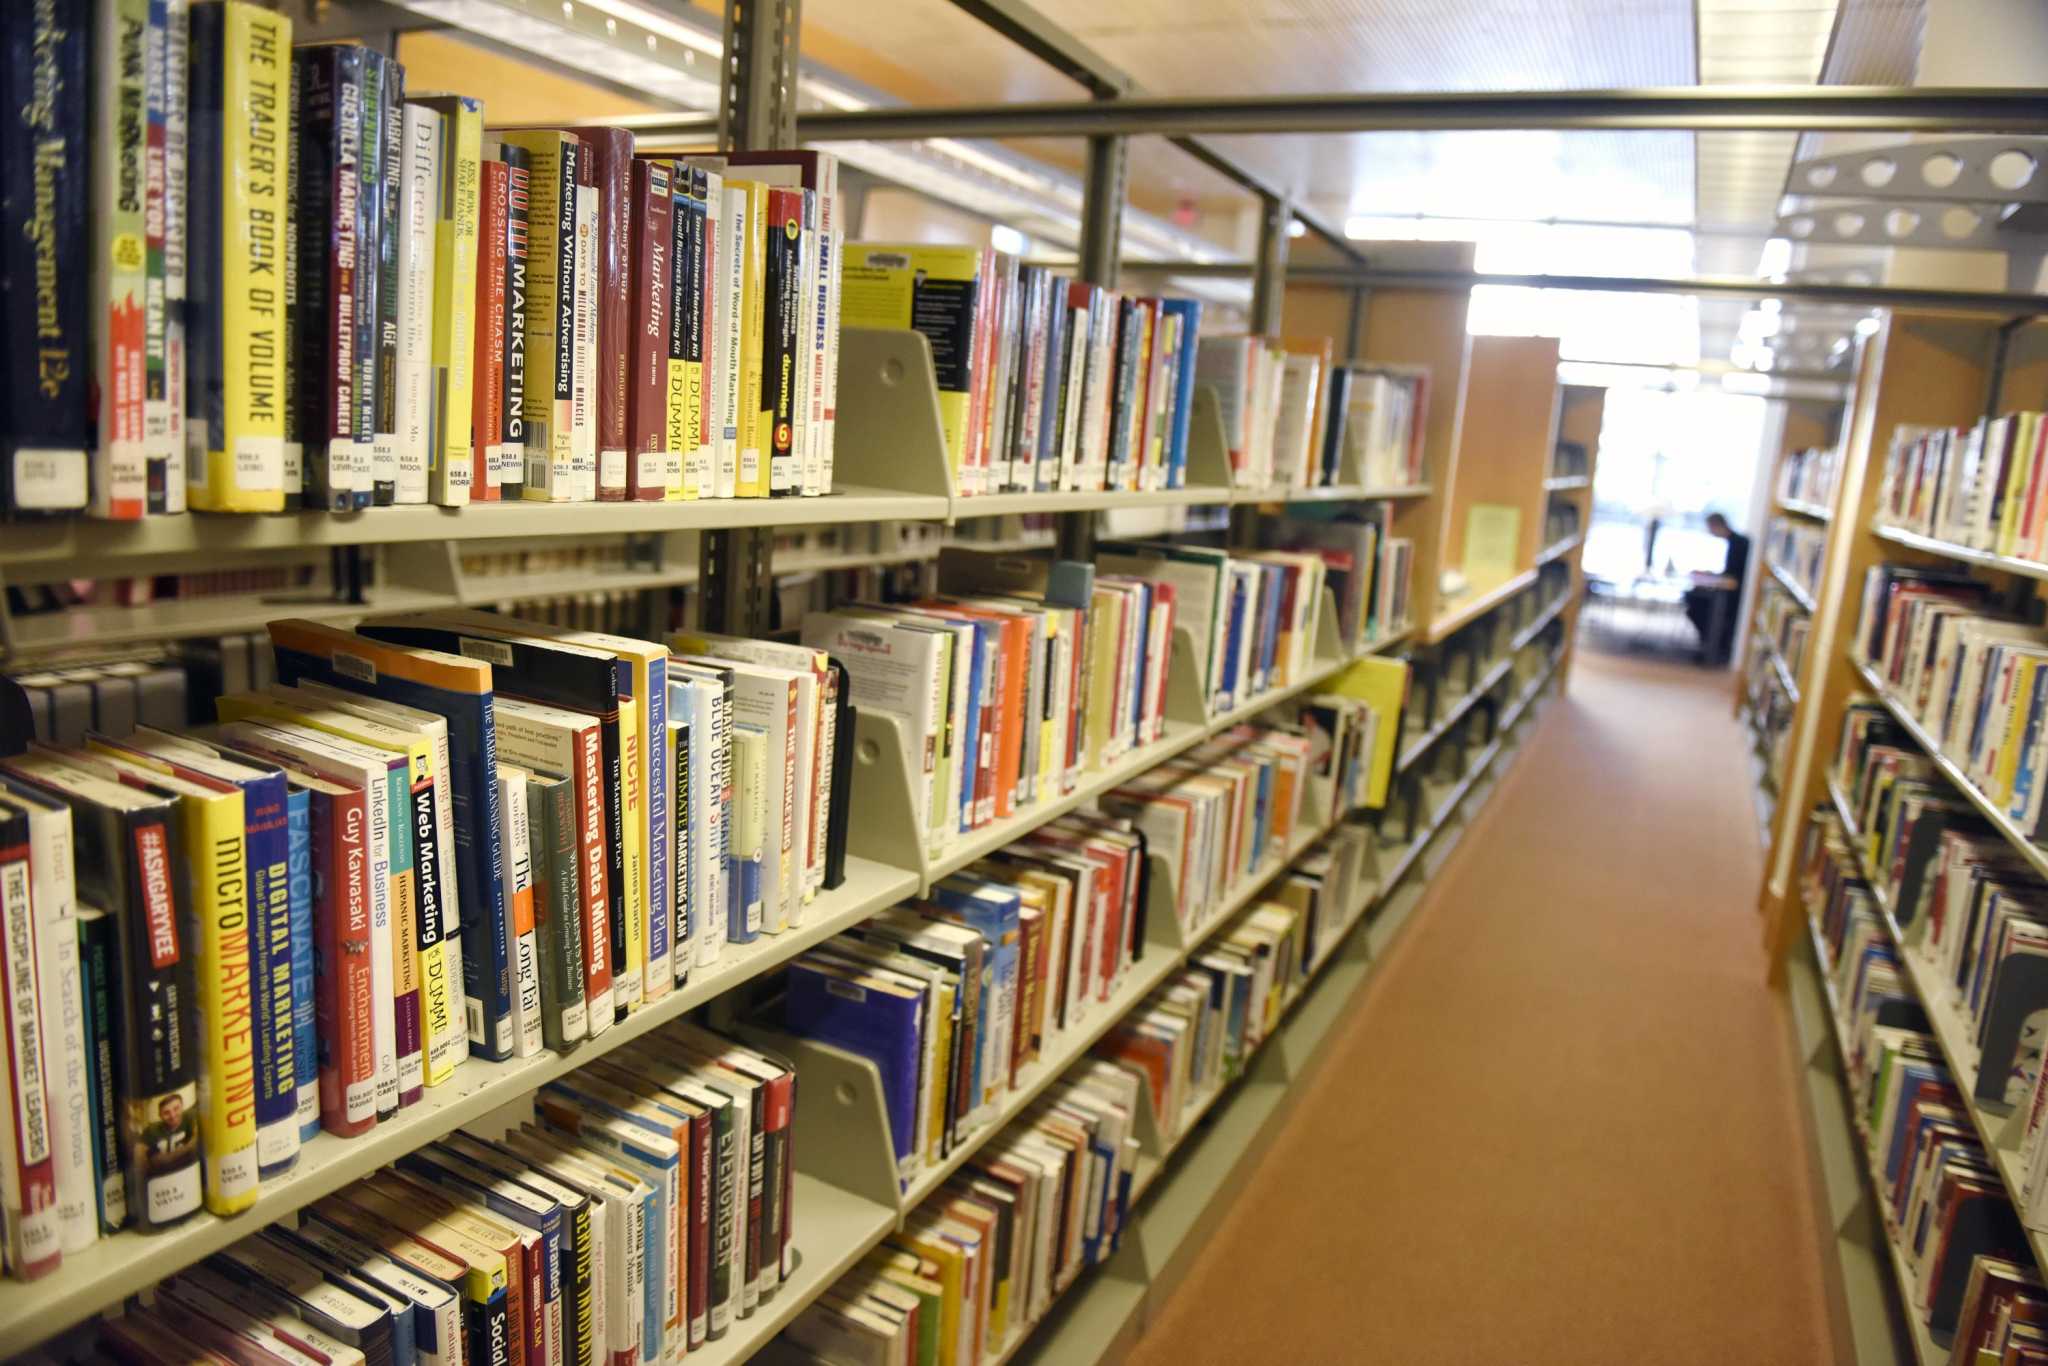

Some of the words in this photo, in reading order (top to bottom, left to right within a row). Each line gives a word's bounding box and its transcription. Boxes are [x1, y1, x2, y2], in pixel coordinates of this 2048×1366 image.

[250, 22, 276, 70] THE
[250, 80, 276, 198] TRADER'S
[339, 82, 359, 166] GUERILLA
[386, 106, 402, 187] MARKETING
[147, 147, 165, 195] LIKE
[414, 124, 433, 236] Different
[508, 166, 529, 211] DO
[562, 150, 576, 231] Marketing
[622, 171, 631, 192] the
[22, 136, 66, 338] Management
[146, 197, 164, 239] YOU
[337, 168, 358, 270] MARKETING
[465, 221, 474, 237] OR
[496, 171, 507, 258] CROSSING
[507, 218, 529, 259] IT!
[620, 196, 630, 248] anatomy
[676, 208, 685, 240] Small
[693, 214, 703, 245] Small
[735, 213, 743, 233] The
[249, 208, 275, 278] BOOK
[286, 222, 298, 305] NONPROFITS
[561, 234, 574, 300] Without
[580, 239, 588, 268] DAYS
[675, 241, 684, 289] Business
[733, 235, 743, 274] Secrets
[819, 234, 830, 280] SMALL
[495, 264, 505, 297] THE
[620, 271, 629, 302] buzz
[648, 242, 667, 338] Marketing
[692, 247, 701, 292] Business
[784, 248, 793, 299] Marketing
[792, 264, 800, 291] Small
[147, 277, 164, 336] MEAN
[249, 287, 275, 319] OF
[577, 290, 587, 342] MILLIONAIRE
[673, 290, 683, 336] Marketing
[691, 293, 701, 342] Marketing
[782, 300, 792, 348] Strategies
[790, 293, 800, 335] Business
[815, 284, 828, 351] BUSINESS
[147, 339, 164, 362] IT
[337, 294, 353, 381] BULLETPROOF
[383, 320, 397, 348] AGE
[494, 303, 504, 363] CHASM
[509, 263, 526, 438] MARKETING
[558, 304, 573, 393] Advertising
[673, 338, 681, 356] Kit
[691, 342, 700, 358] Kit
[729, 291, 741, 370] Word-of-Mouth
[39, 348, 70, 399] 12e
[249, 329, 274, 424] VOLUME
[363, 358, 374, 402] ROBERT
[619, 353, 627, 402] emanuel
[725, 372, 737, 425] Marketing
[779, 353, 791, 419] dummies
[337, 386, 352, 435] CAREER
[362, 405, 373, 443] McKEE
[575, 386, 585, 428] MIRACLES
[617, 409, 625, 436] rosen
[610, 665, 618, 698] Cohen
[650, 689, 662, 720] The
[484, 703, 495, 725] The
[709, 697, 722, 743] BLUE
[437, 735, 448, 761] The
[485, 726, 498, 777] MARKET
[721, 700, 734, 789] MARKETING
[786, 724, 798, 758] THE
[438, 765, 451, 803] Long
[584, 731, 602, 844] Mastering
[613, 756, 621, 777] THE
[626, 733, 639, 813] NICHE
[650, 722, 666, 819] Successful
[677, 748, 689, 829] ULTIMATE
[709, 748, 722, 808] OCEAN
[342, 807, 366, 845] Guy
[371, 776, 387, 841] LinkedIn
[417, 791, 433, 841] Web
[442, 805, 453, 833] Tail
[487, 778, 500, 842] PLANNING
[511, 792, 522, 848] ANDERSON
[614, 779, 623, 843] MARKETING
[782, 759, 796, 852] MARKETING
[52, 831, 67, 883] Trout
[373, 843, 385, 860] for
[615, 842, 623, 870] PLAN
[718, 800, 731, 873] STRATEGY
[8, 869, 24, 900] THE
[254, 870, 267, 901] Global
[490, 841, 502, 883] GUIDE
[561, 878, 570, 894] Field
[588, 847, 604, 898] Data
[631, 853, 641, 896] James
[650, 822, 666, 915] Marketing
[676, 829, 689, 906] MARKETING
[141, 831, 175, 960] #ASKGARYVEE
[268, 861, 289, 956] DIGITAL
[288, 807, 316, 999] FASCINATE
[347, 848, 367, 933] Kawasaki
[374, 860, 390, 928] Business
[399, 874, 410, 924] HISPANIC
[422, 845, 441, 946] Marketing
[562, 895, 571, 914] Guide
[255, 902, 268, 951] Strategies
[563, 922, 574, 951] Growing
[590, 899, 607, 976] Mining
[633, 899, 641, 942] Harkin
[652, 913, 668, 956] Plan
[676, 904, 687, 940] PLAN
[12, 904, 30, 993] DISCIPLINE
[259, 952, 269, 974] from
[402, 927, 413, 992] MARKETING
[515, 929, 535, 985] Long
[61, 965, 80, 1029] Search
[166, 984, 178, 1007] GARY
[522, 985, 538, 1012] Tai
[566, 966, 576, 992] Business
[18, 996, 31, 1018] OF
[272, 961, 295, 1095] MARKETING
[356, 966, 372, 1082] Enchantment
[20, 1021, 38, 1088] MARKET
[64, 1033, 78, 1053] of
[261, 1027, 274, 1066] Leading
[67, 1059, 82, 1089] the
[98, 1040, 115, 1127] UNDERSTANDING
[262, 1065, 275, 1100] Experts
[25, 1090, 45, 1162] LEADERS
[69, 1092, 86, 1169] Obvious
[717, 1128, 736, 1267] EVERGREEN
[547, 1233, 561, 1300] branded
[576, 1210, 592, 1284] SERVICE
[446, 1309, 461, 1361] Creating
[490, 1312, 507, 1366] Social
[533, 1317, 543, 1349] CRM
